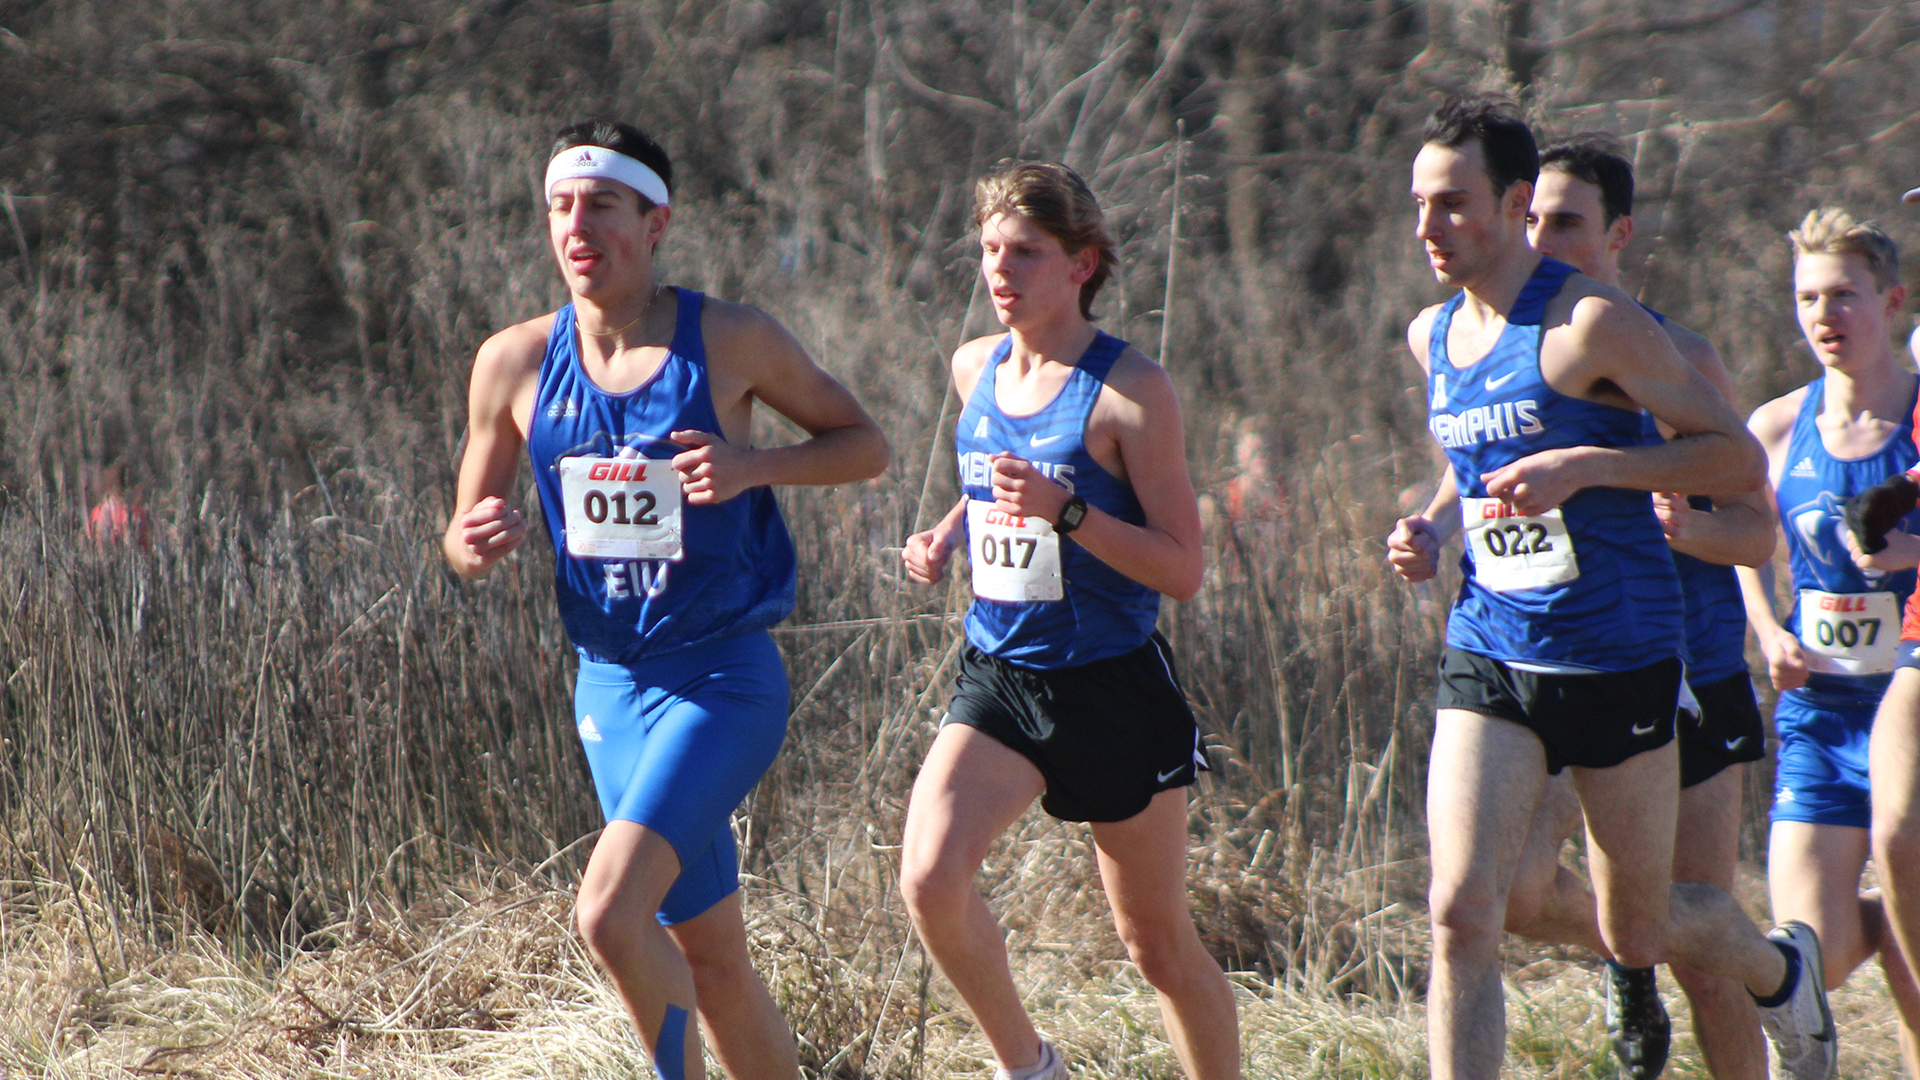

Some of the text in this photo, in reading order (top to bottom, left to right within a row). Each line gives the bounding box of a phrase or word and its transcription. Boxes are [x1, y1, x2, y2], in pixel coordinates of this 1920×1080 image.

[1429, 400, 1544, 448] EMPHIS
[588, 462, 648, 482] GILL
[583, 489, 658, 525] 012
[981, 534, 1038, 569] 017
[1483, 523, 1553, 557] 022
[603, 560, 667, 598] EIU
[1819, 596, 1867, 612] GILL
[1815, 618, 1881, 648] 007
